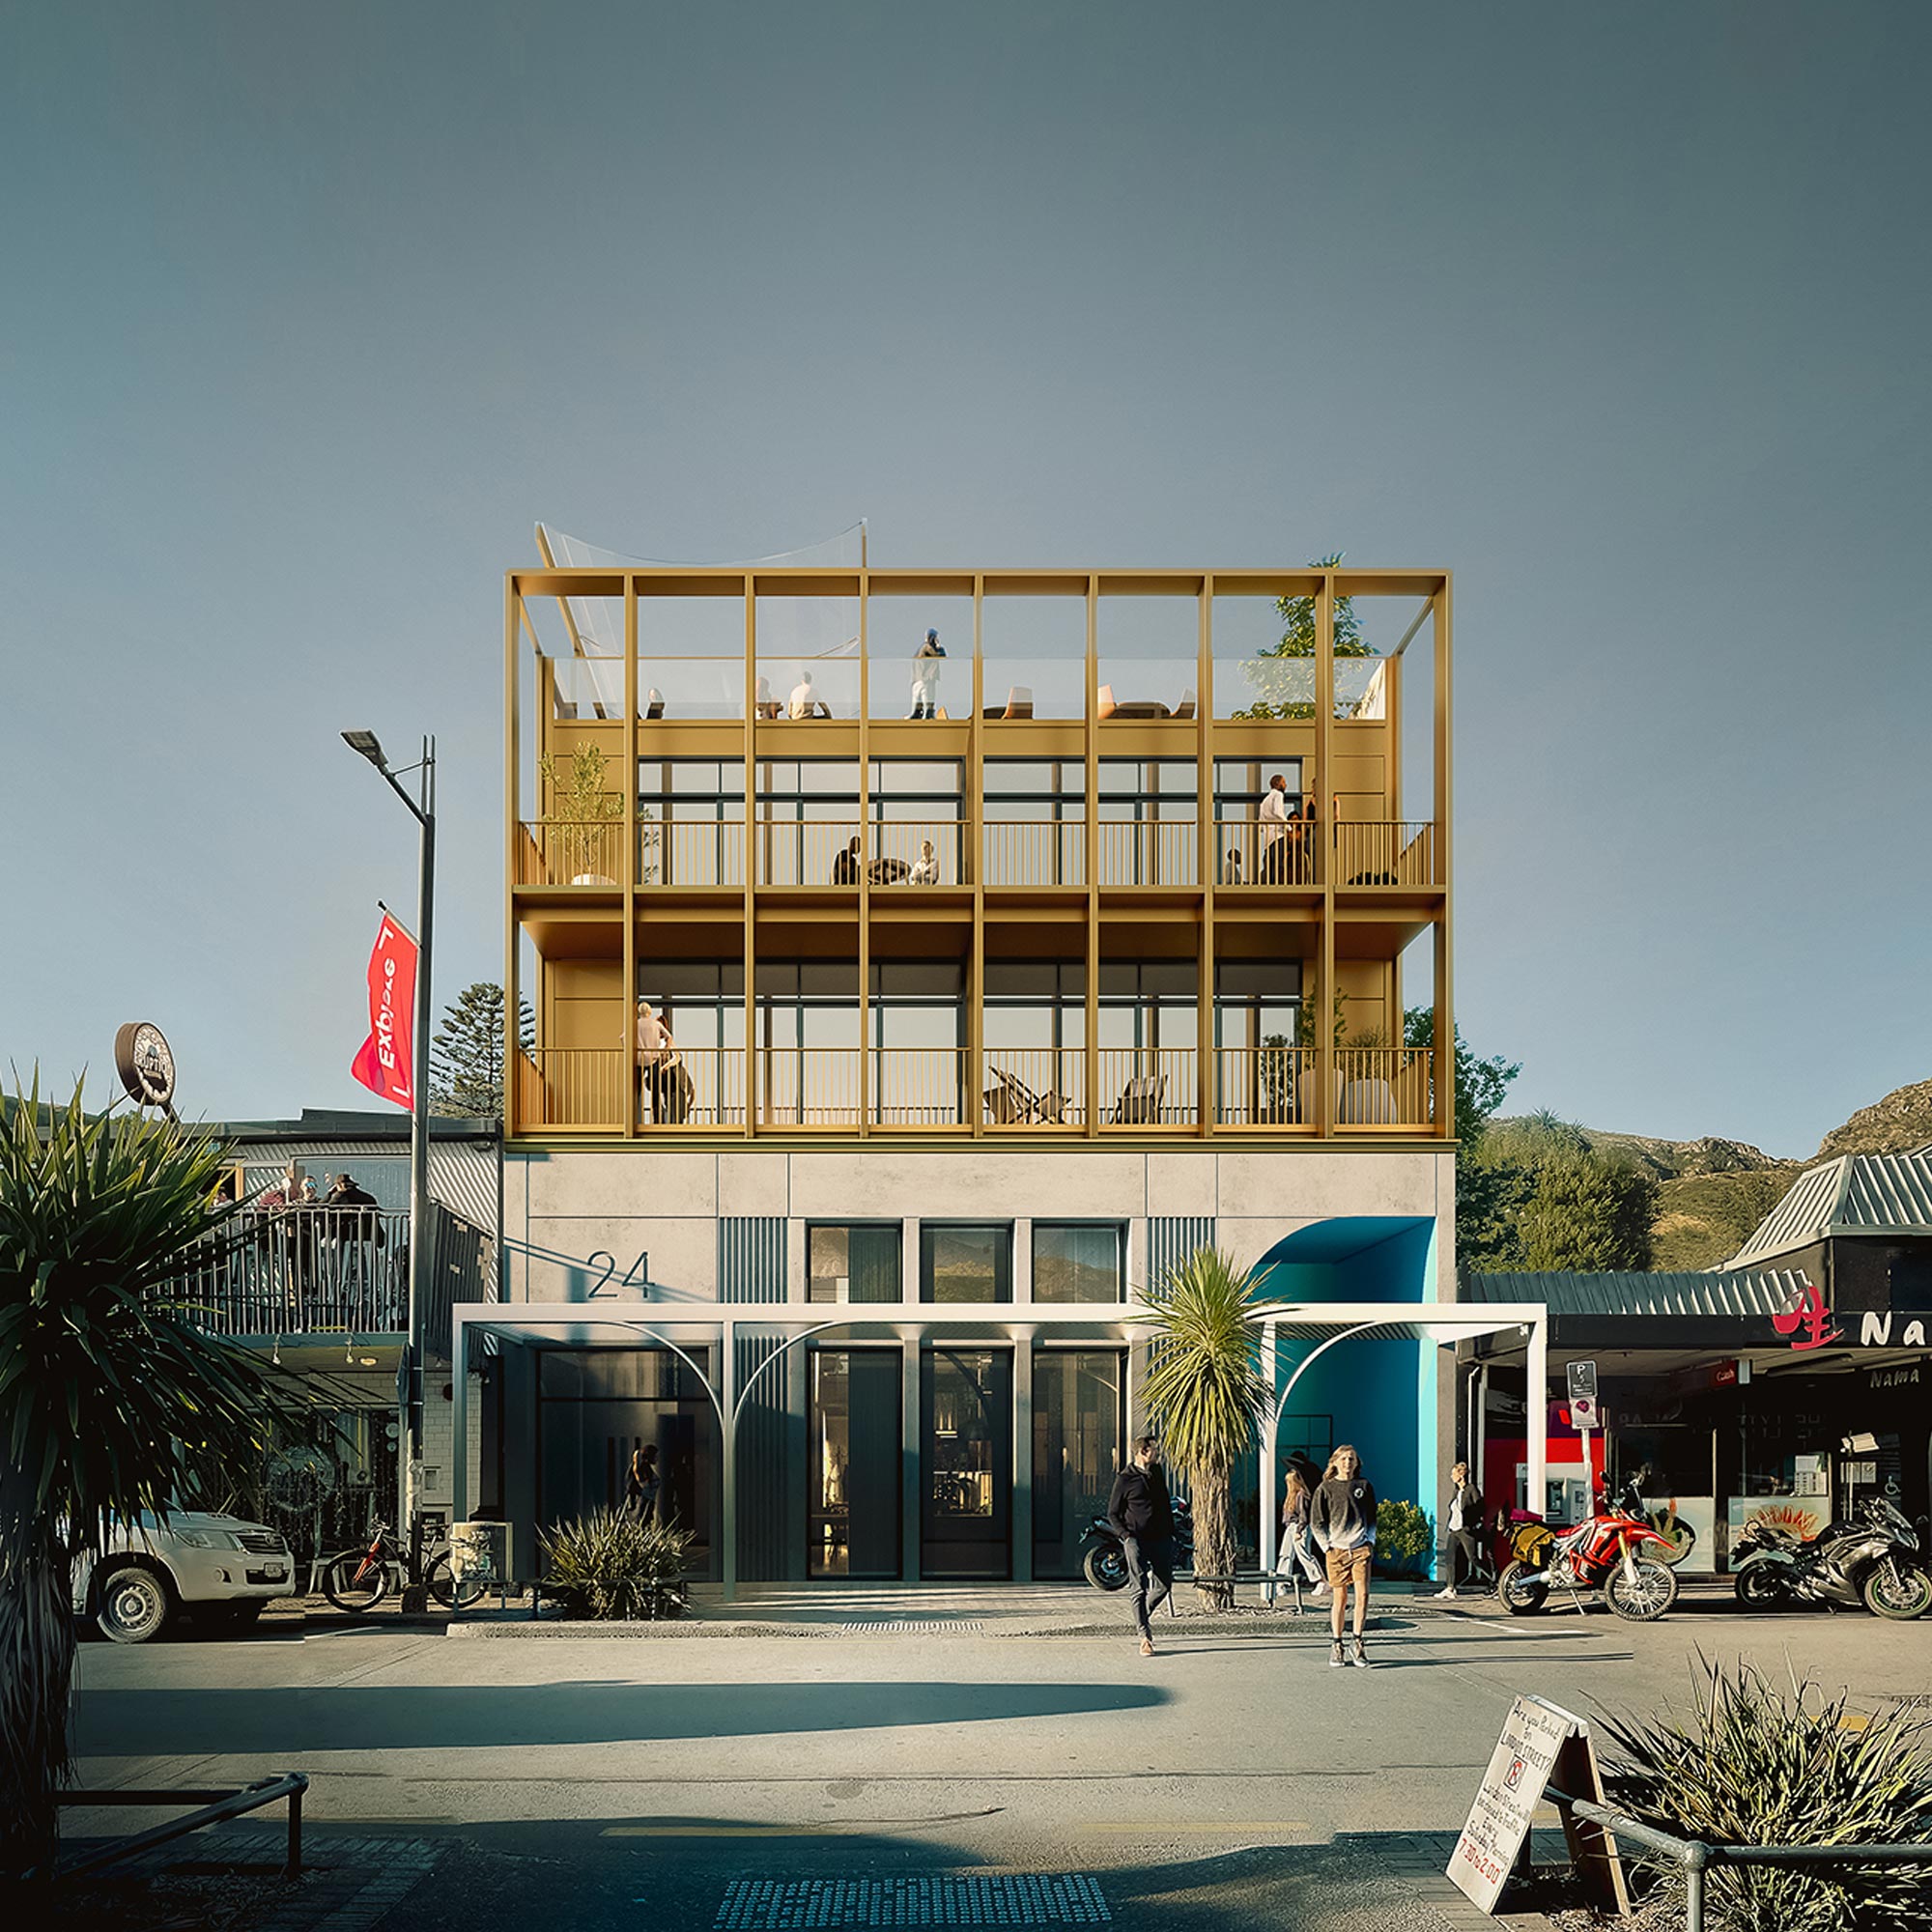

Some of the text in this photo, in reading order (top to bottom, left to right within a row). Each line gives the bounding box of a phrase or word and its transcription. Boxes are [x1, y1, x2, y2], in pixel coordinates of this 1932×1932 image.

[588, 1251, 655, 1298] 24
[1577, 1365, 1585, 1375] P
[1870, 1369, 1919, 1388] Nama
